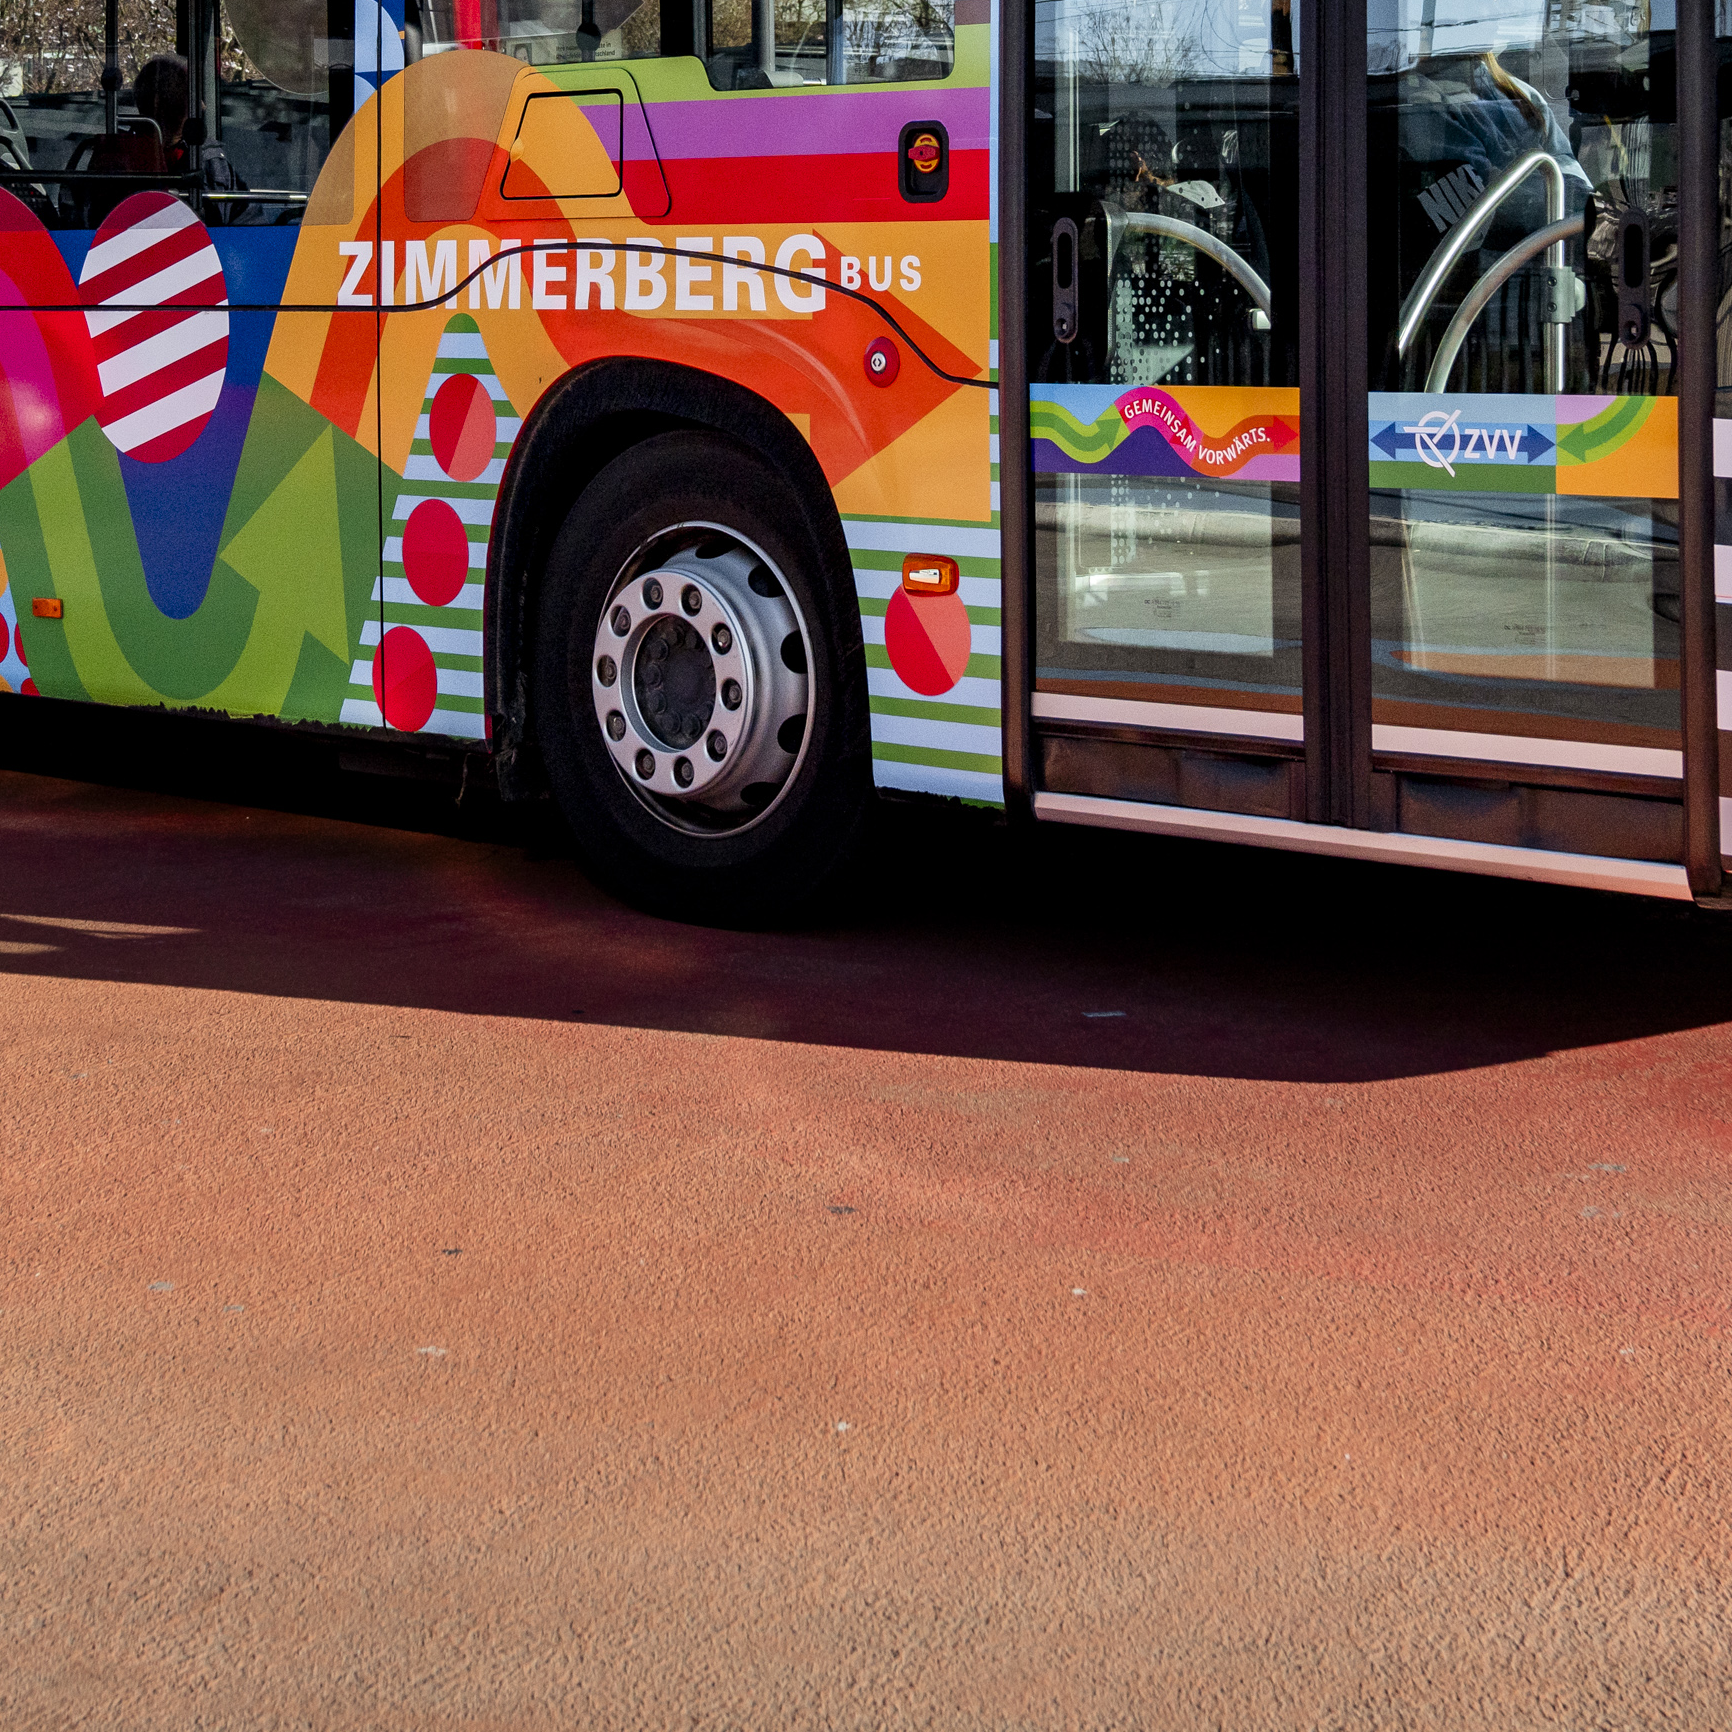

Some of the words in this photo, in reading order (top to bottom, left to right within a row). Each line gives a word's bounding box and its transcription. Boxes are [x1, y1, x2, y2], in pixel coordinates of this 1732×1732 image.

[337, 233, 827, 314] ZIMMERBERG
[840, 254, 922, 292] BUS
[1124, 398, 1197, 453] GEMEINSAM
[1198, 426, 1271, 465] VORWÄRTS.
[1463, 428, 1523, 460] ZVV
